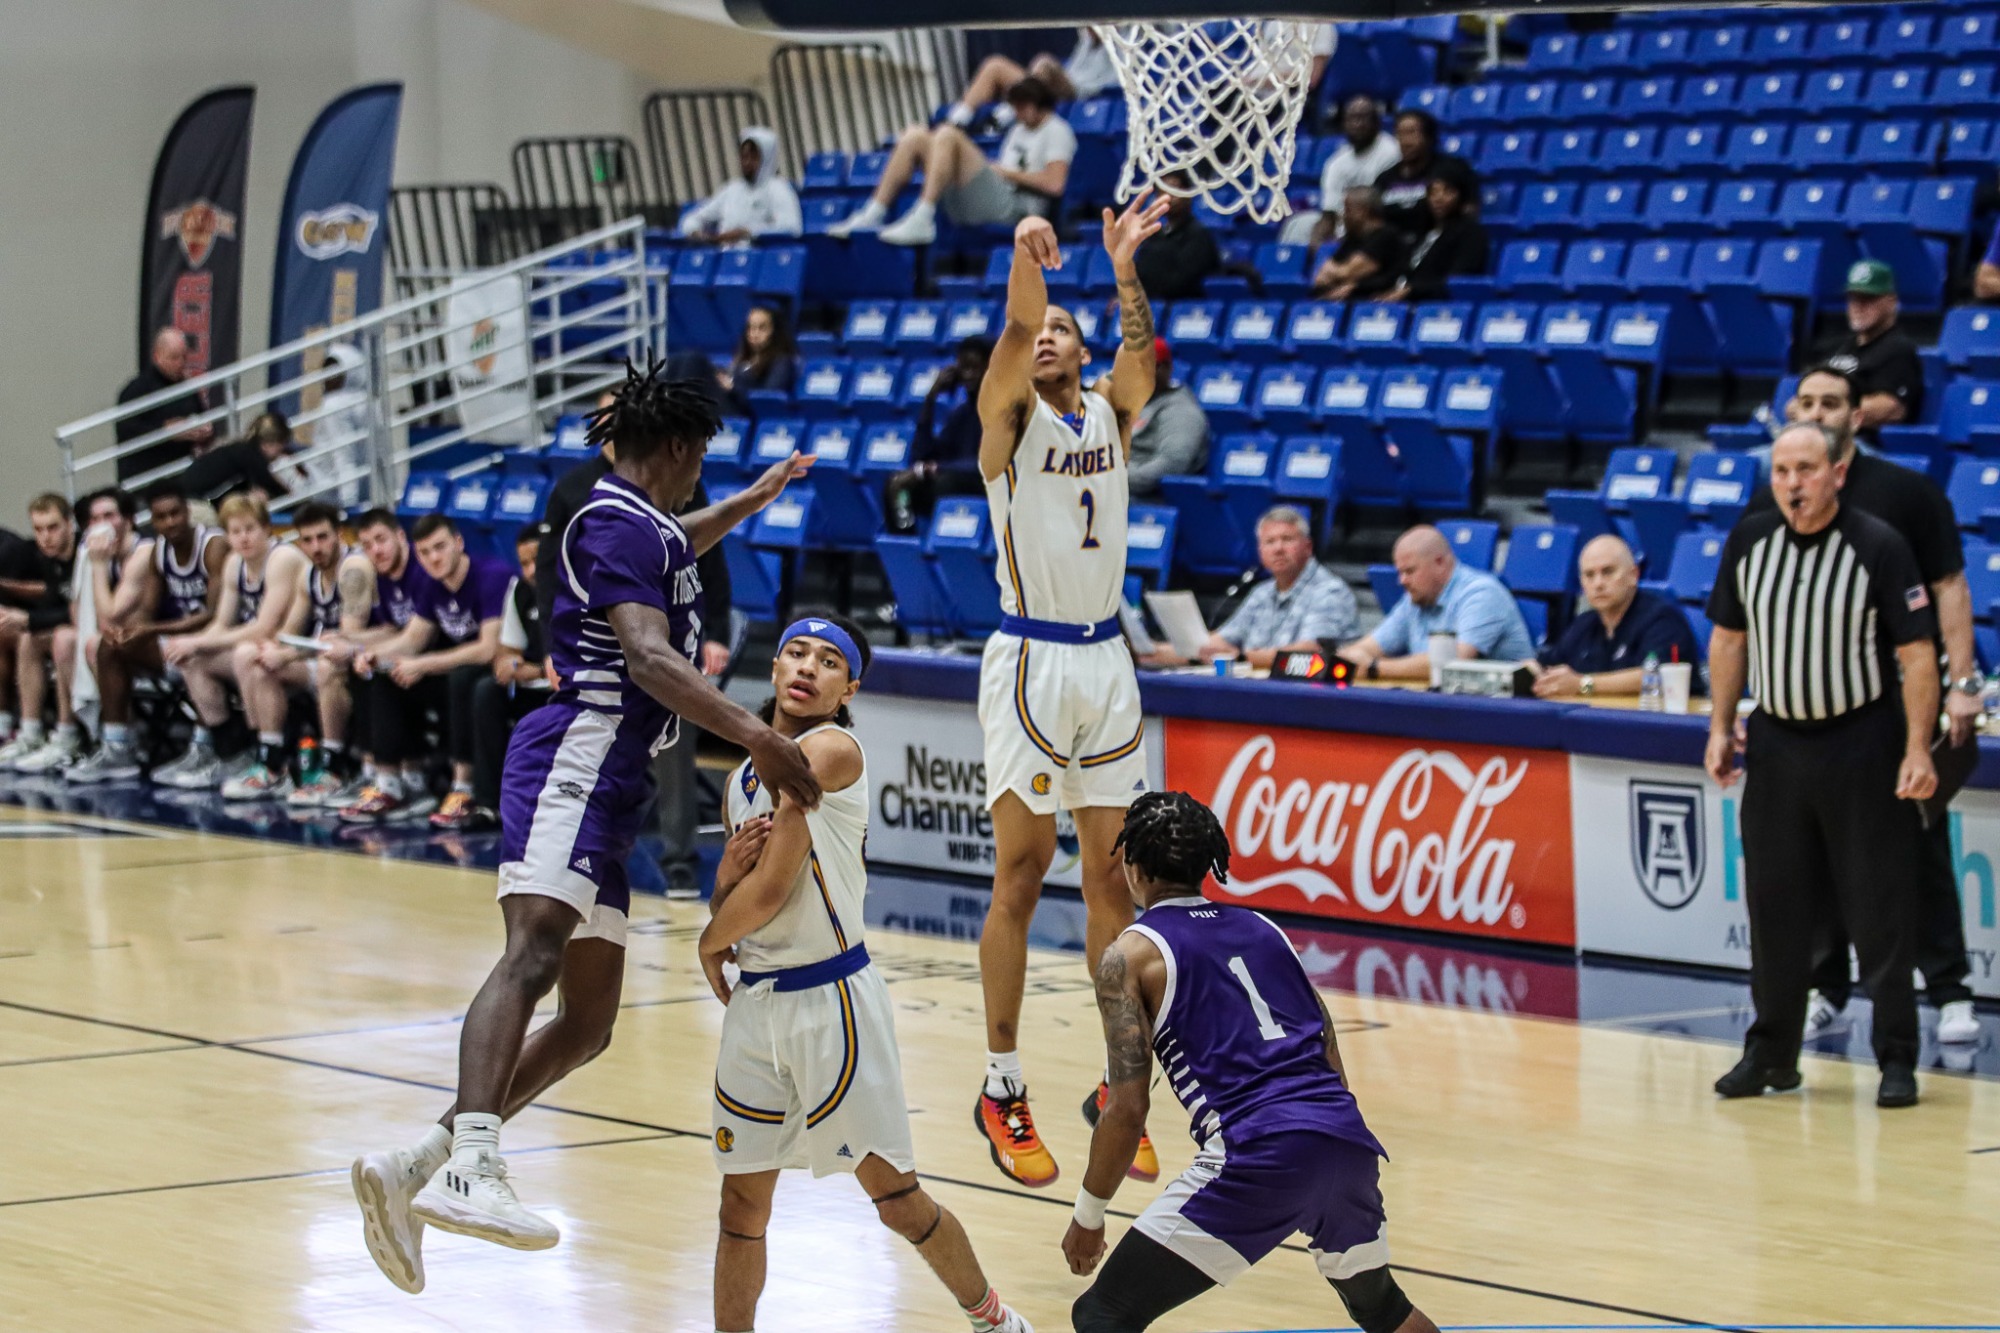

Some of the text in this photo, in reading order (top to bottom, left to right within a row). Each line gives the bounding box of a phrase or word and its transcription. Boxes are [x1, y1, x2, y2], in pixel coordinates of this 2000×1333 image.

[1080, 487, 1100, 549] 2
[905, 744, 986, 796] News
[880, 783, 994, 838] Channe
[1210, 733, 1529, 926] Coca-Cola
[1227, 956, 1287, 1040] 1
